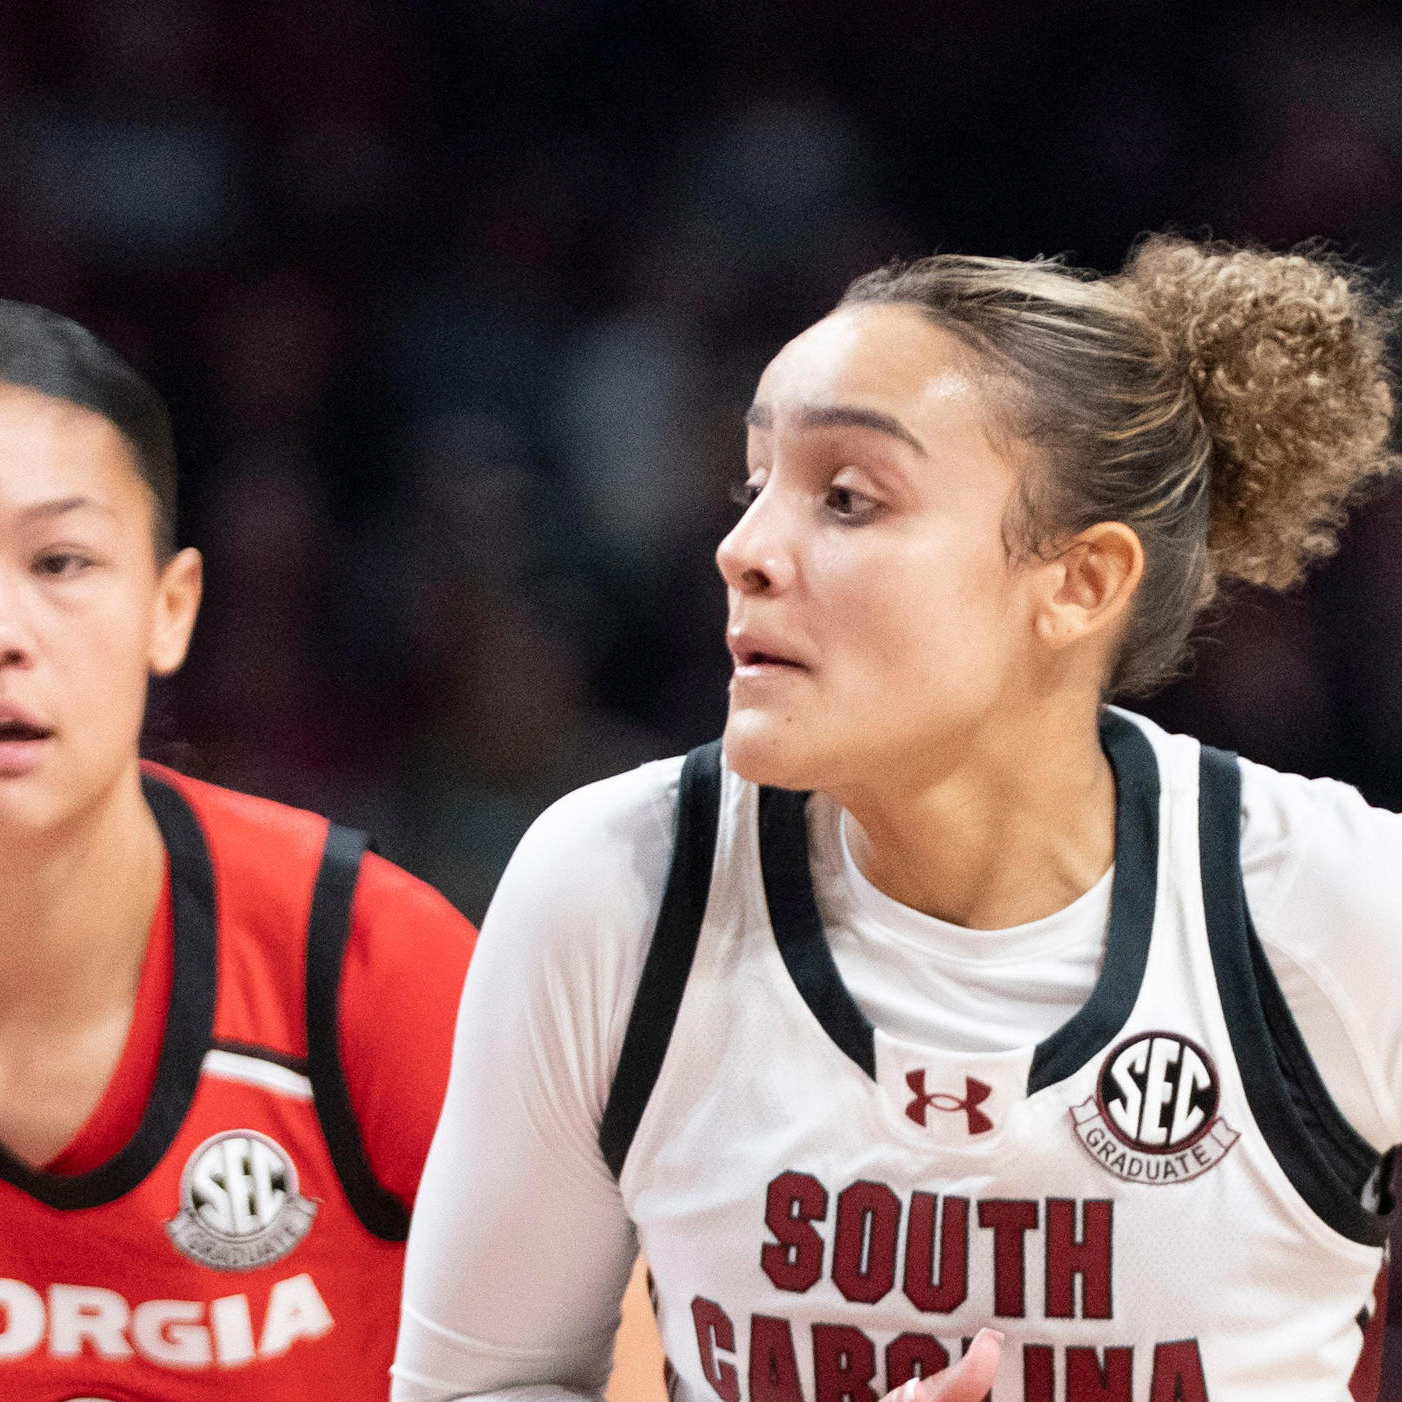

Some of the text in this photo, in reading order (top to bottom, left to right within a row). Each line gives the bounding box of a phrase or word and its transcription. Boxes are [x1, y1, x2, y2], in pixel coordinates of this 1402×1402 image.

[1108, 1037, 1211, 1145] SEC
[192, 1138, 285, 1233] SEC
[1086, 1128, 1210, 1180] GRADUATE
[761, 1170, 1114, 1319] SOUTH
